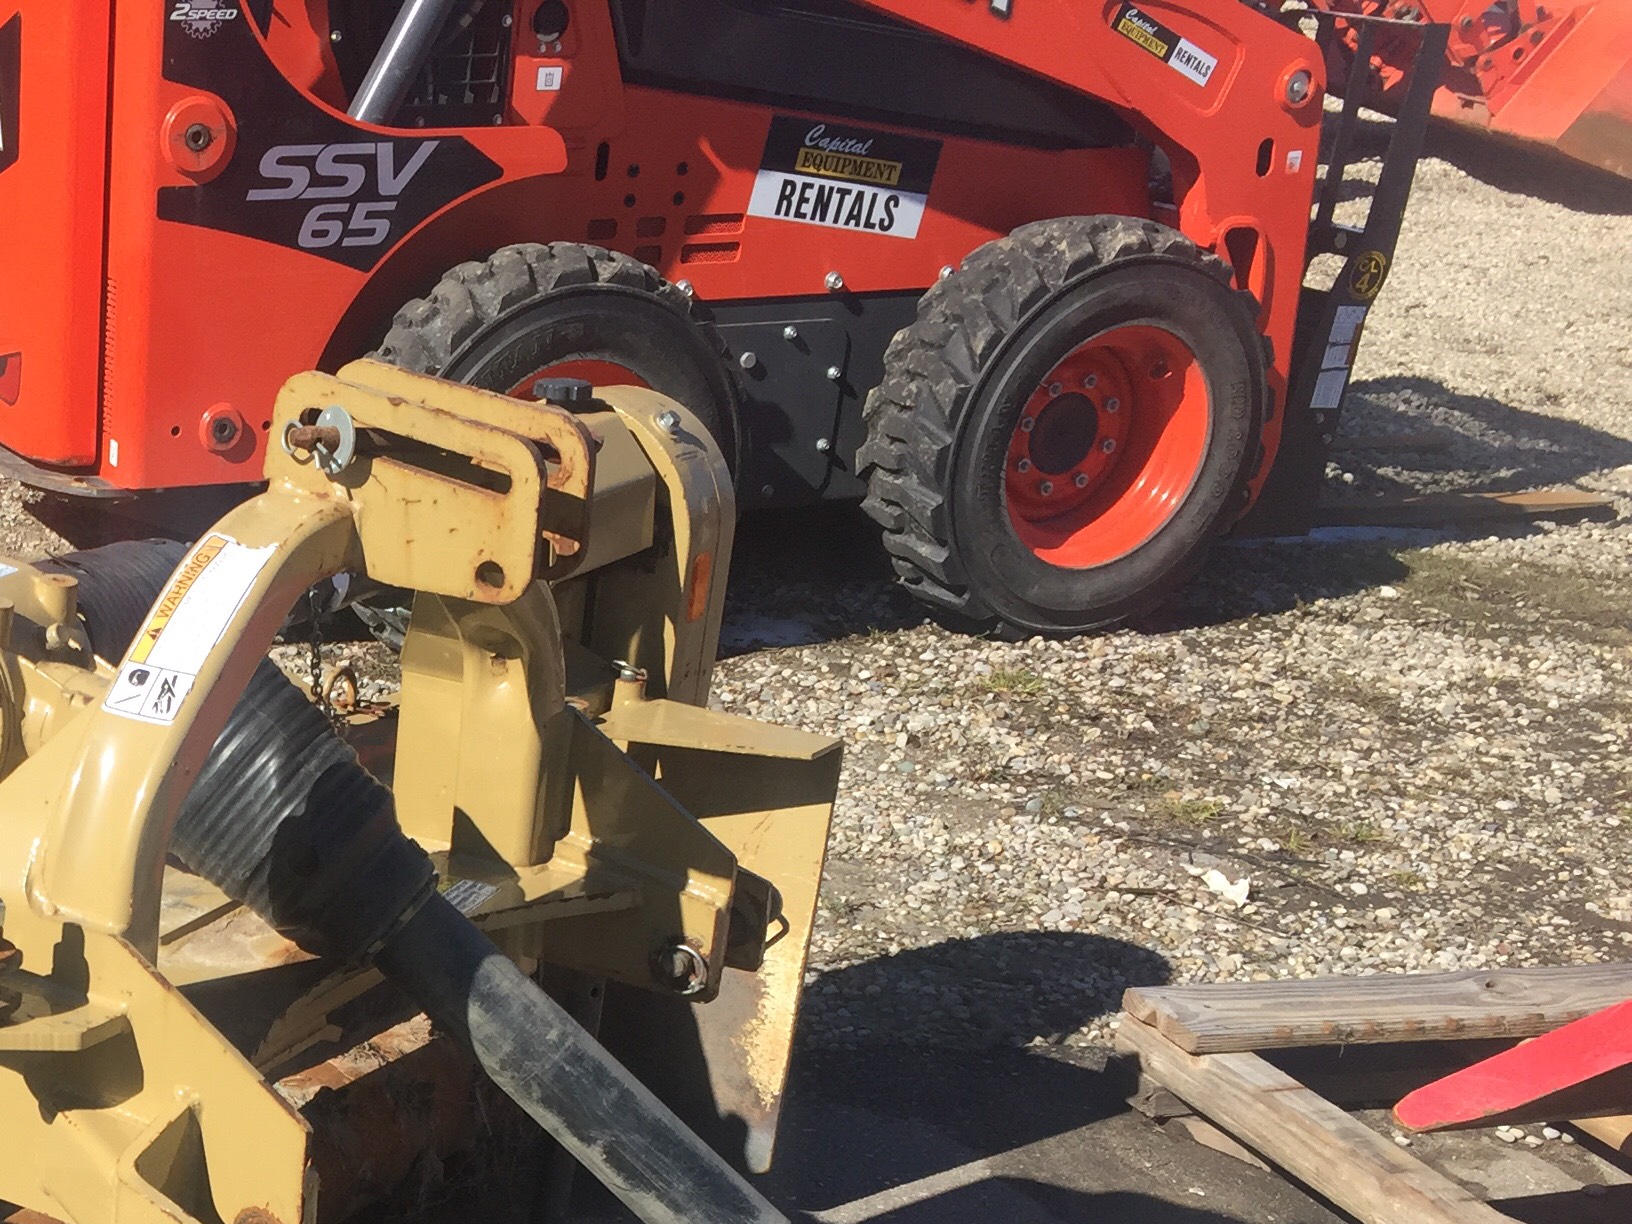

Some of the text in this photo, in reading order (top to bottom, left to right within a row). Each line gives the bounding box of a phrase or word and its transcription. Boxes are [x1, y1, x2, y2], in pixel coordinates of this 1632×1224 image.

[1121, 21, 1165, 54] EQUIPMENT
[1174, 47, 1211, 78] RENTALS
[804, 124, 873, 155] Capital
[246, 140, 440, 200] SSV
[800, 152, 897, 182] EQUIPMENT
[297, 201, 397, 248] 65
[774, 178, 900, 232] RENTALS
[157, 552, 211, 618] WARNING
